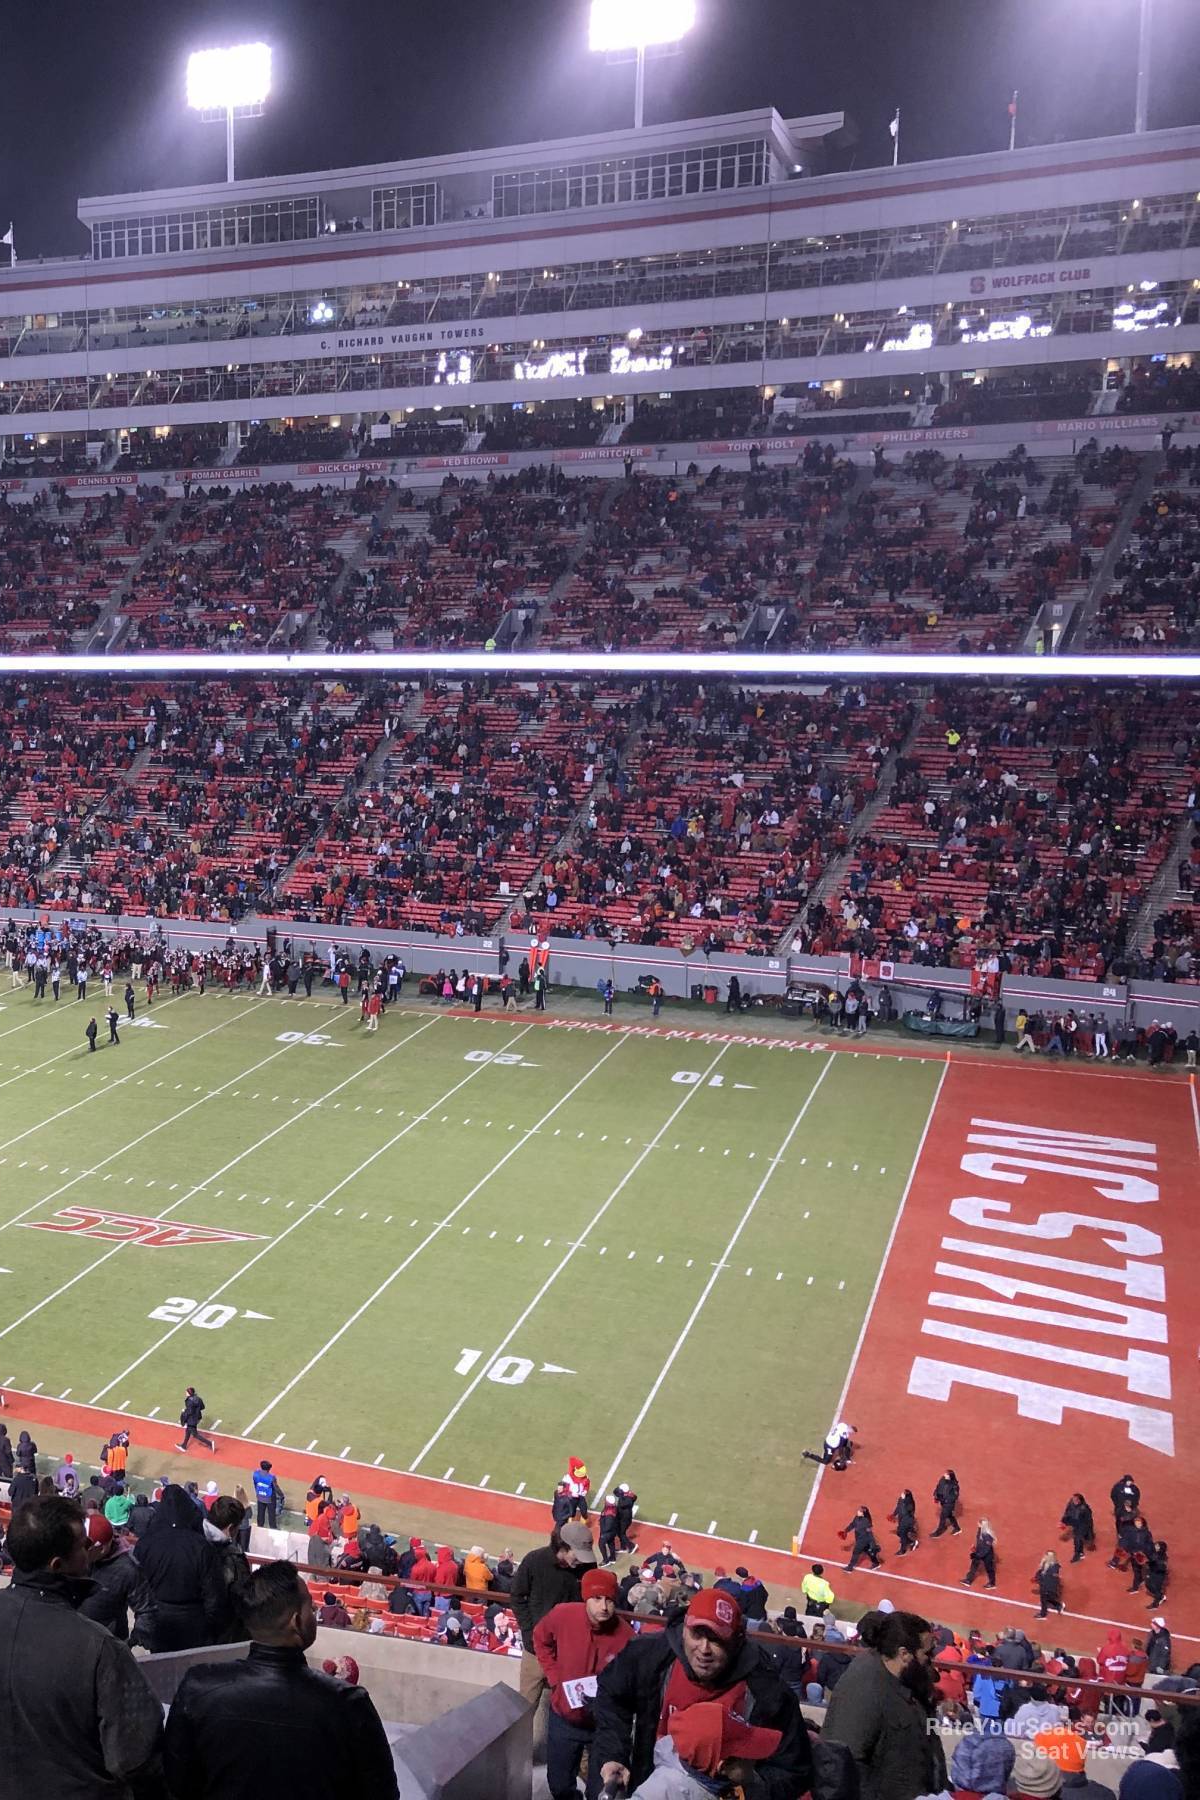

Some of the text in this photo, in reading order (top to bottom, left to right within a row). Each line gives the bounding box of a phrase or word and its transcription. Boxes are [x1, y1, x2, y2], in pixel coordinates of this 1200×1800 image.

[992, 269, 1090, 288] WOLFPACK CLUB
[321, 328, 485, 349] C. RICHARD VAUGHN TOWERS
[1057, 417, 1159, 433] MARIO WILLIAMS
[883, 428, 969, 443] PHILIP RIVERS
[766, 440, 796, 449] HOLT
[442, 456, 499, 466] TED BROWN
[579, 448, 644, 460] JIM RITCHER
[191, 468, 259, 479] ROMAN GABRIEL
[318, 462, 382, 473] DICK CHRISTY
[77, 475, 132, 485] DENNIS BYRD
[548, 1018, 613, 1032] PACK
[616, 1024, 661, 1037] THE
[275, 1031, 332, 1045] 30
[700, 1032, 829, 1050] STRENGTH
[463, 1050, 524, 1065] 20
[671, 1071, 724, 1087] 10
[960, 1118, 1160, 1203] NC
[15, 1205, 273, 1247] ACC
[148, 1297, 238, 1330] 20
[907, 1196, 1176, 1457] STATE
[453, 1347, 535, 1385] 10
